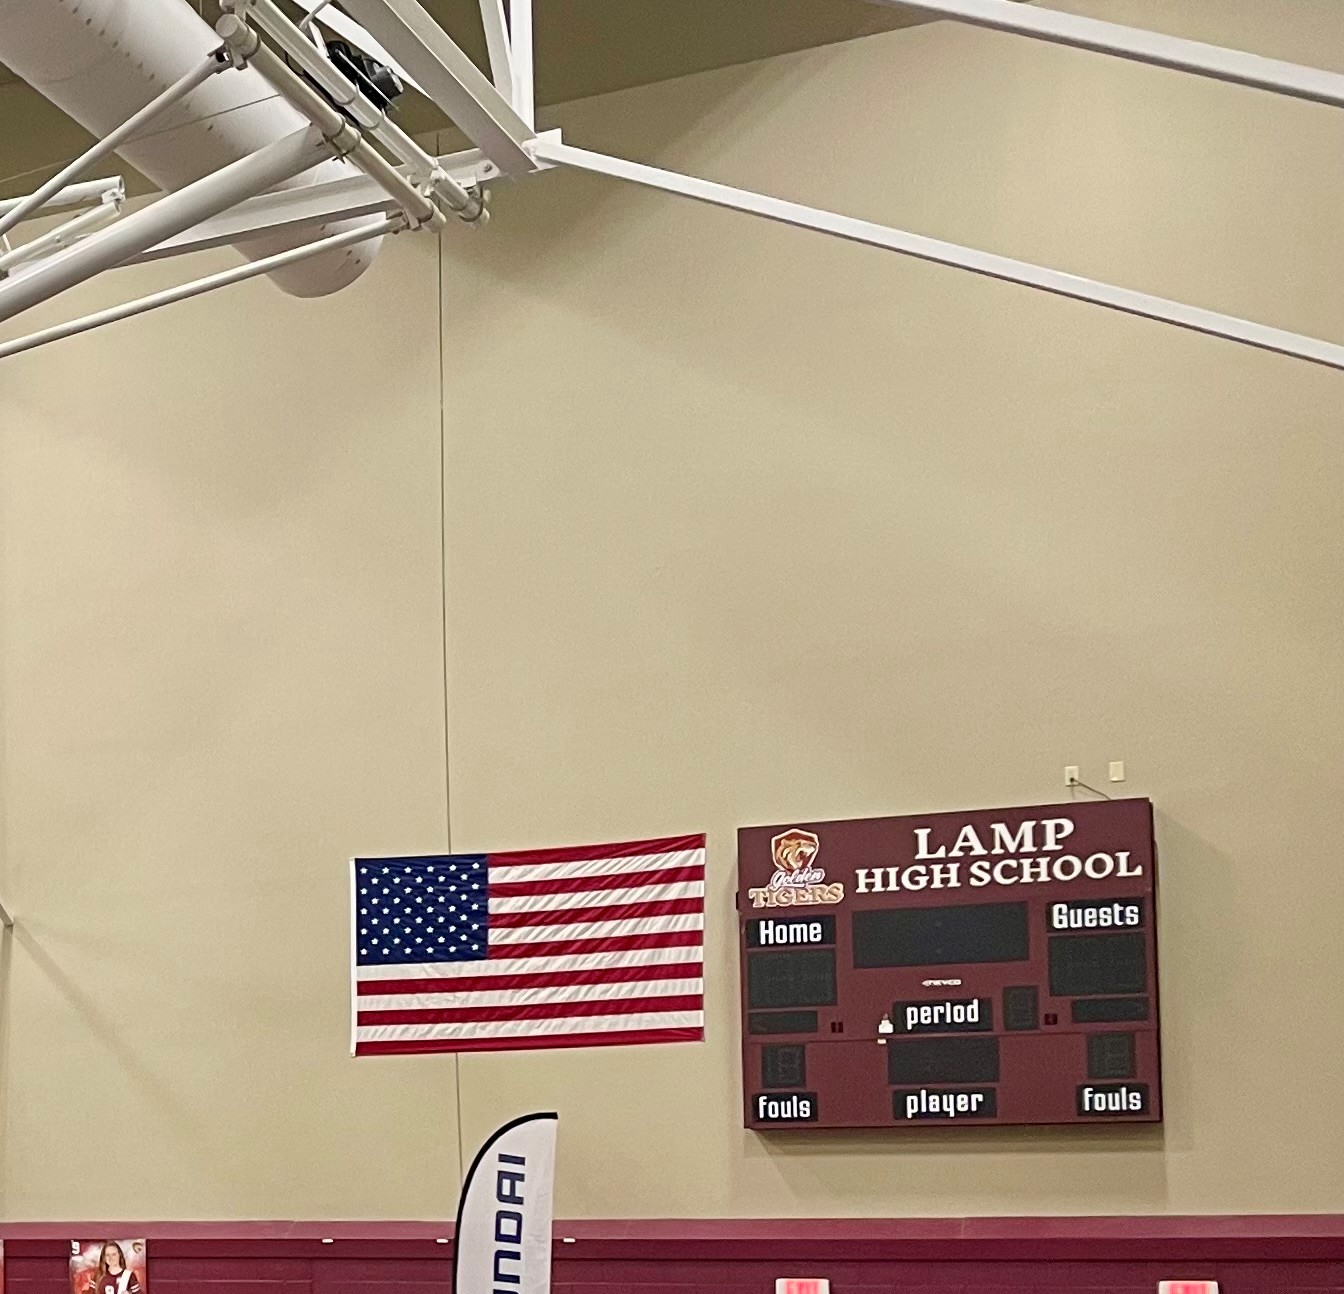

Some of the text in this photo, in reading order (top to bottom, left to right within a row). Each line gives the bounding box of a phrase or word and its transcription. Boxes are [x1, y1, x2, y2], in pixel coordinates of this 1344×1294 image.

[914, 818, 1075, 860] LAMP
[855, 851, 1143, 894] HIGH SCHOOL
[749, 883, 844, 907] TIGERS
[1052, 903, 1140, 929] Guests
[759, 920, 822, 945] Home
[906, 999, 979, 1029] period
[759, 1096, 811, 1119] fouls
[906, 1091, 984, 1118] player
[1083, 1088, 1142, 1112] fouls
[72, 1241, 80, 1255] 9
